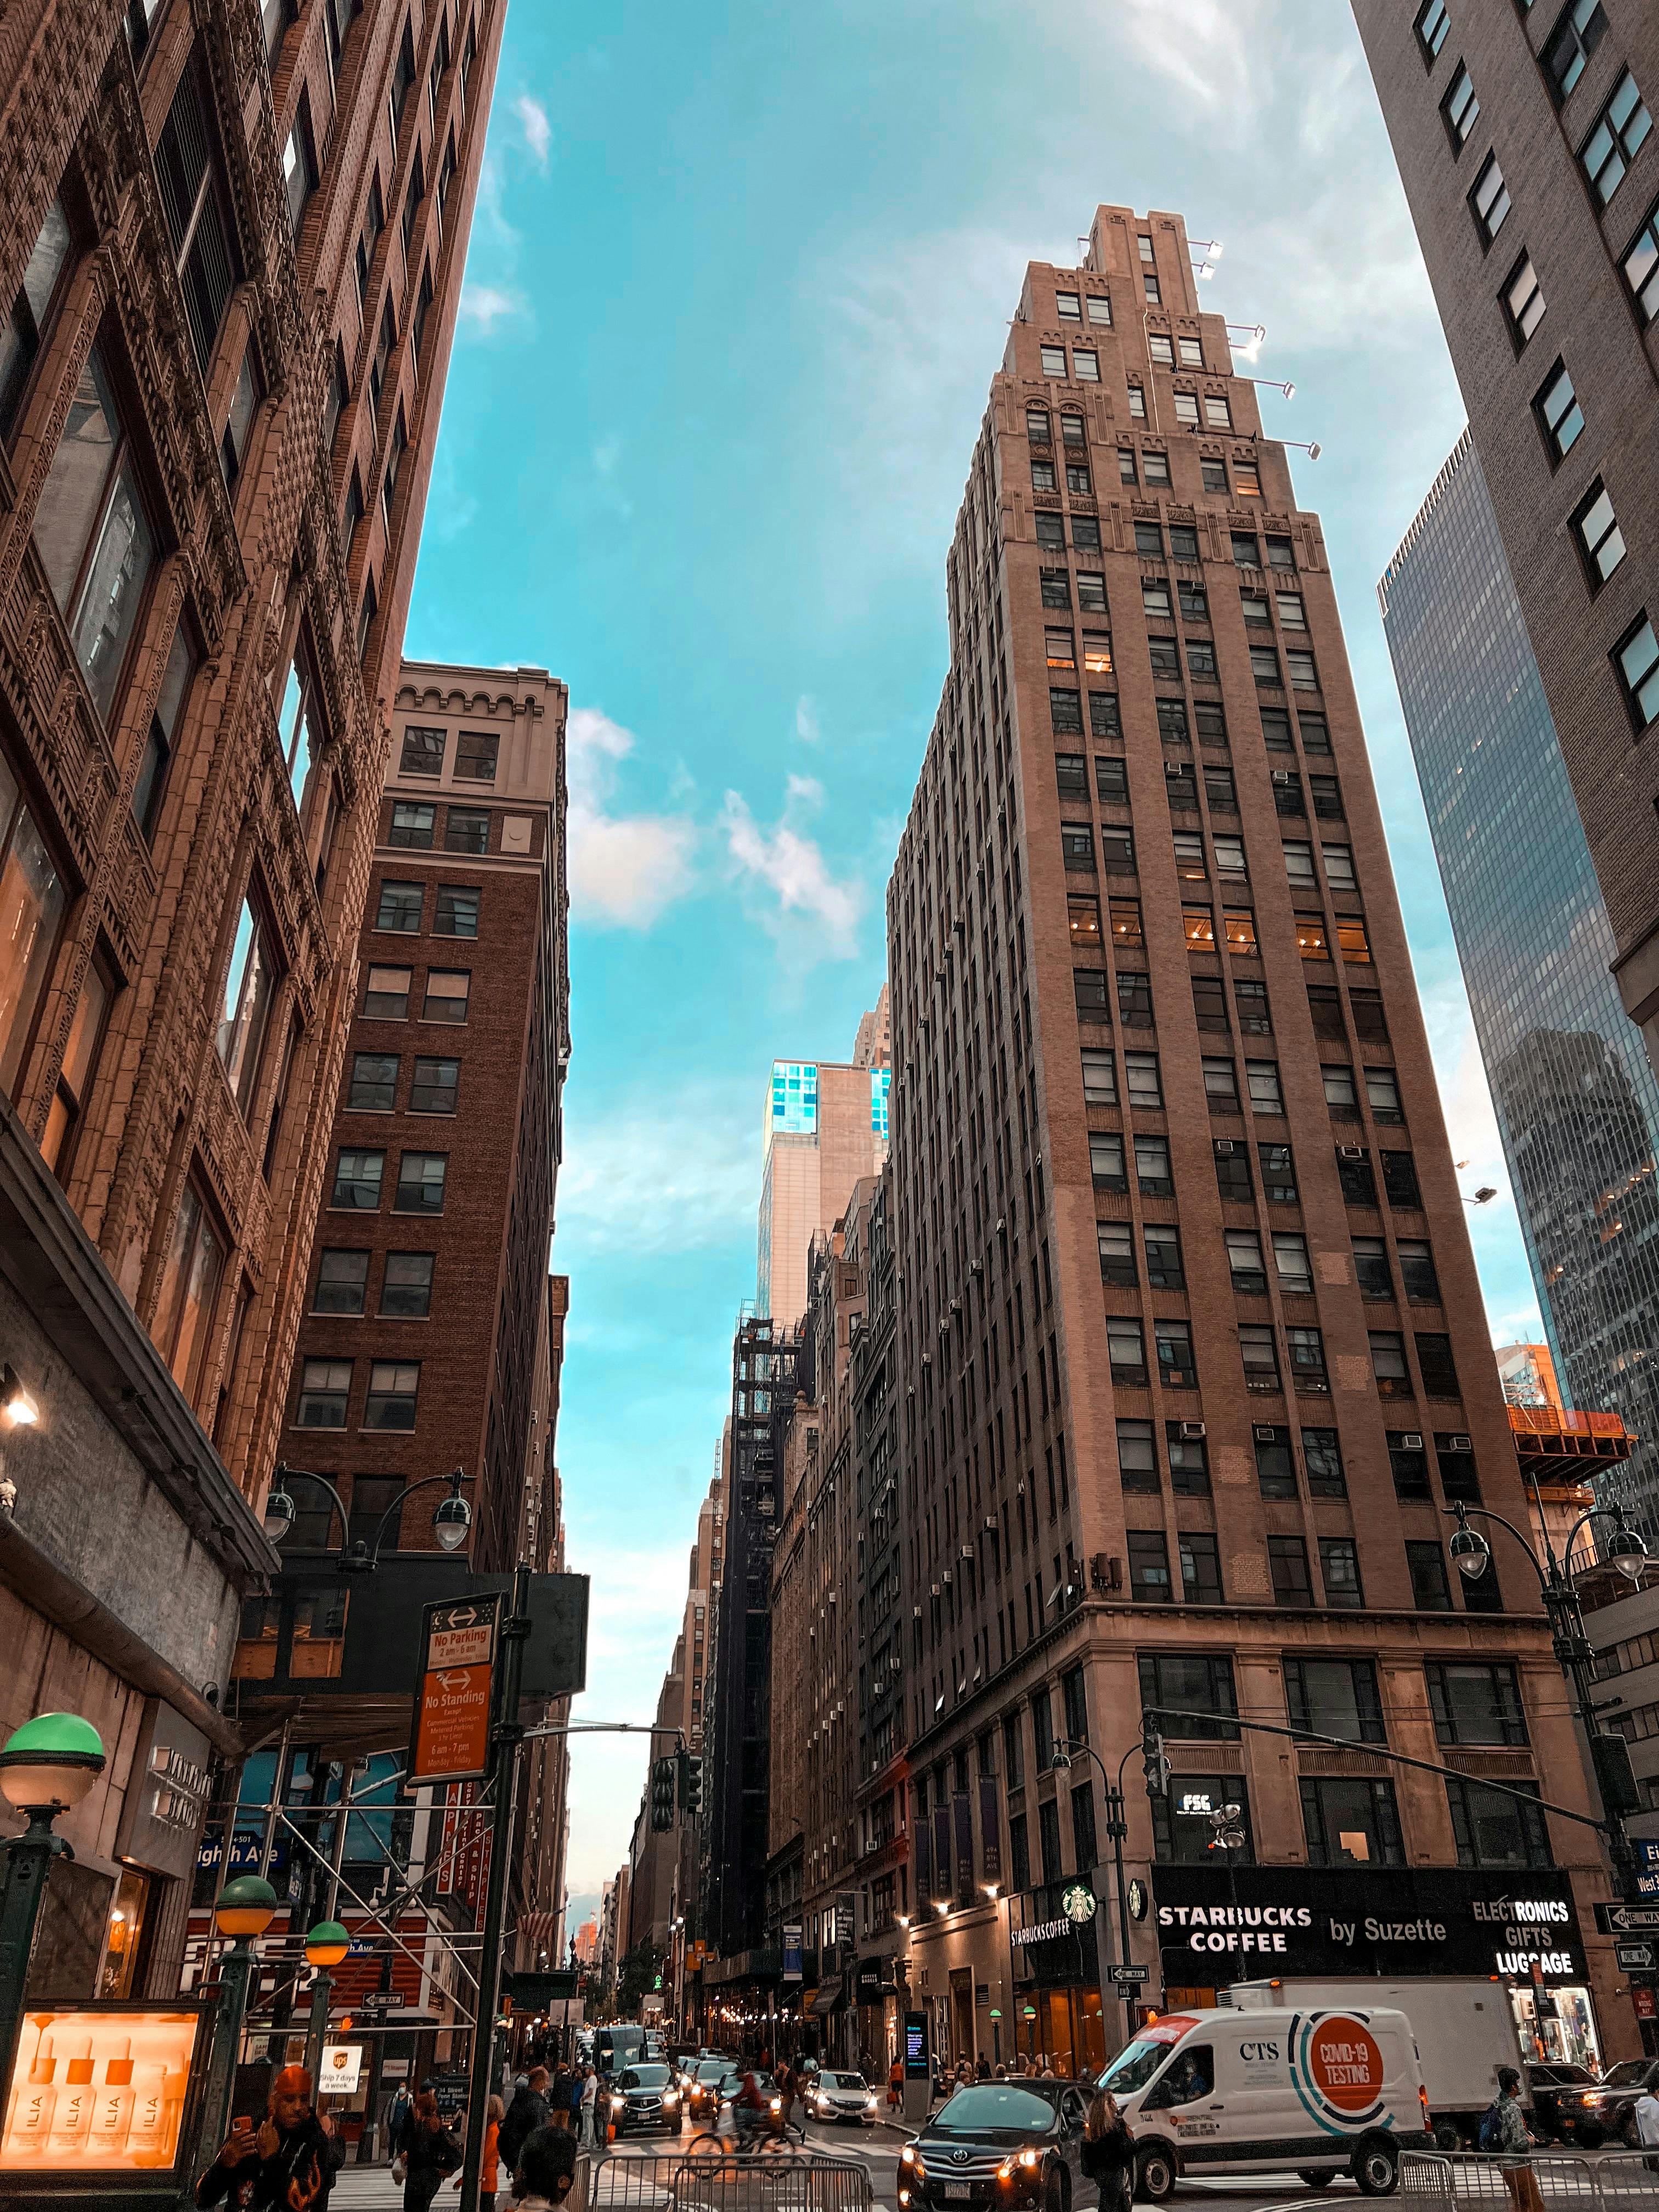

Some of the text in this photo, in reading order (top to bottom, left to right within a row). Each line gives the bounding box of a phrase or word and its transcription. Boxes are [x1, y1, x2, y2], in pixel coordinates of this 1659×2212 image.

[435, 1629, 487, 1647] No Parking
[440, 1648, 444, 1656] 2
[466, 1645, 476, 1653] am
[426, 1690, 485, 1709] No Standing
[432, 1745, 436, 1754] 6
[437, 1746, 447, 1754] am
[453, 1743, 458, 1752] 7
[458, 1742, 469, 1754] pm
[428, 1757, 449, 1767] Monday
[454, 1754, 471, 1764] Friday
[1183, 1795, 1211, 1810] FSG
[198, 1845, 278, 1867] ighh Ae
[469, 1865, 477, 1899] Ship
[1637, 1876, 1656, 1892] West
[1472, 1901, 1568, 1921] ELECTRONICS
[1619, 1913, 1637, 1923] ONE
[1011, 1917, 1070, 1946] STARBUCKS COFFEE
[1159, 1907, 1447, 1946] STARBUCKS by Suzette
[1190, 1932, 1287, 1952] COFFEE
[1505, 1927, 1552, 1946] GIFTS
[1623, 1951, 1634, 1961] ONE
[1239, 2042, 1279, 2061] CTS
[1320, 2042, 1369, 2063] COVID-19
[334, 2057, 347, 2068] ups
[340, 2074, 356, 2083] days
[1325, 2064, 1370, 2084] TESTING
[27, 2096, 43, 2127] ILIA
[66, 2096, 82, 2127] ILIA
[105, 2097, 121, 2128] ILIA
[143, 2097, 159, 2127] ILIA
